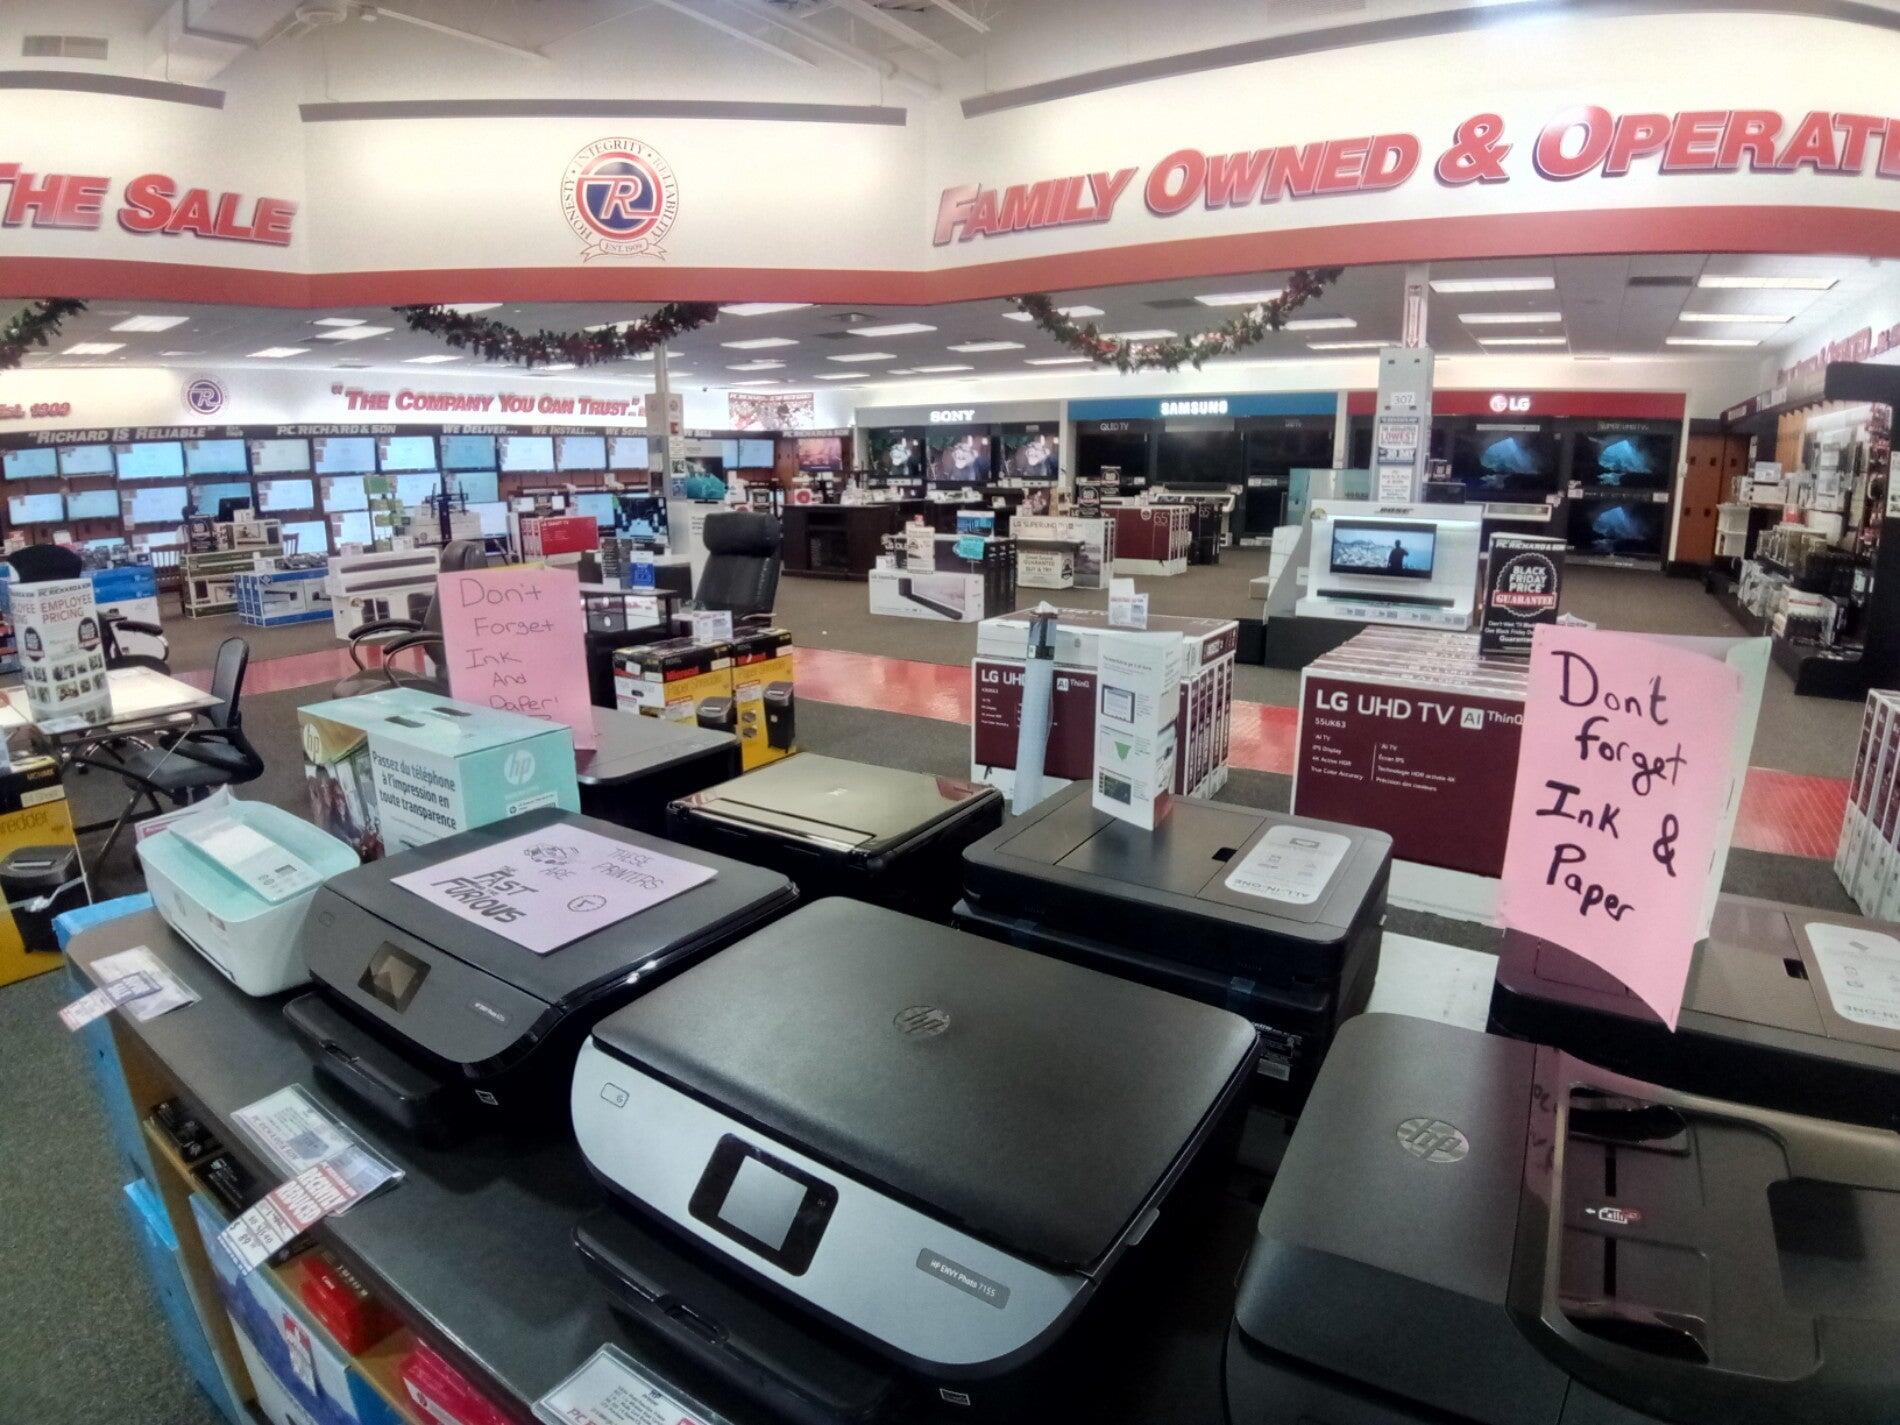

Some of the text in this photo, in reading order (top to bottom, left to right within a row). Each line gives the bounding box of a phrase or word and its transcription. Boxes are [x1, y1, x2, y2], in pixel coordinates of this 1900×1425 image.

[573, 140, 645, 168] INTEGRITY
[933, 166, 1140, 247] FAMILY
[1144, 132, 1422, 218] OWNED
[1435, 112, 1513, 188] &
[117, 173, 298, 247] SALE
[564, 180, 593, 240] HONESTY
[653, 158, 677, 240] RELIABILITY
[396, 387, 493, 412] COMPANY
[499, 393, 535, 413] YOU
[538, 396, 574, 414] CAN
[1160, 401, 1228, 415] SAMSUNG
[1509, 397, 1531, 411] LG
[930, 409, 975, 422] SONY
[1119, 422, 1129, 431] TV
[112, 428, 130, 441] IS
[298, 425, 359, 434] RICHARD
[371, 424, 397, 434] SON
[443, 424, 459, 434] WE
[532, 426, 548, 435] WE
[1510, 574, 1547, 583] FRIDAY
[1513, 566, 1546, 575] BLACK
[41, 593, 92, 613] EMPLOYEE
[460, 578, 542, 608] Don't
[42, 607, 84, 624] PRICING
[474, 616, 555, 637] Forget
[981, 670, 999, 683] LG
[1316, 689, 1348, 711] LG
[1358, 695, 1411, 719] UHD
[1418, 702, 1455, 725] TV
[1487, 710, 1524, 726] ThinQ
[505, 751, 535, 784] hp
[1575, 715, 1687, 796] forget
[372, 751, 456, 792] Passez du téléphone
[379, 790, 457, 830] toute transparence
[439, 795, 450, 809] en
[609, 848, 654, 868] THESE
[1652, 813, 1680, 877] &
[475, 870, 539, 895] FAST
[1546, 843, 1635, 922] Paper
[430, 877, 527, 923] FURIOUS
[1397, 1118, 1469, 1163] hp
[940, 1264, 958, 1278] ENVY
[958, 1273, 977, 1288] Photo
[978, 1282, 996, 1297] 7155
